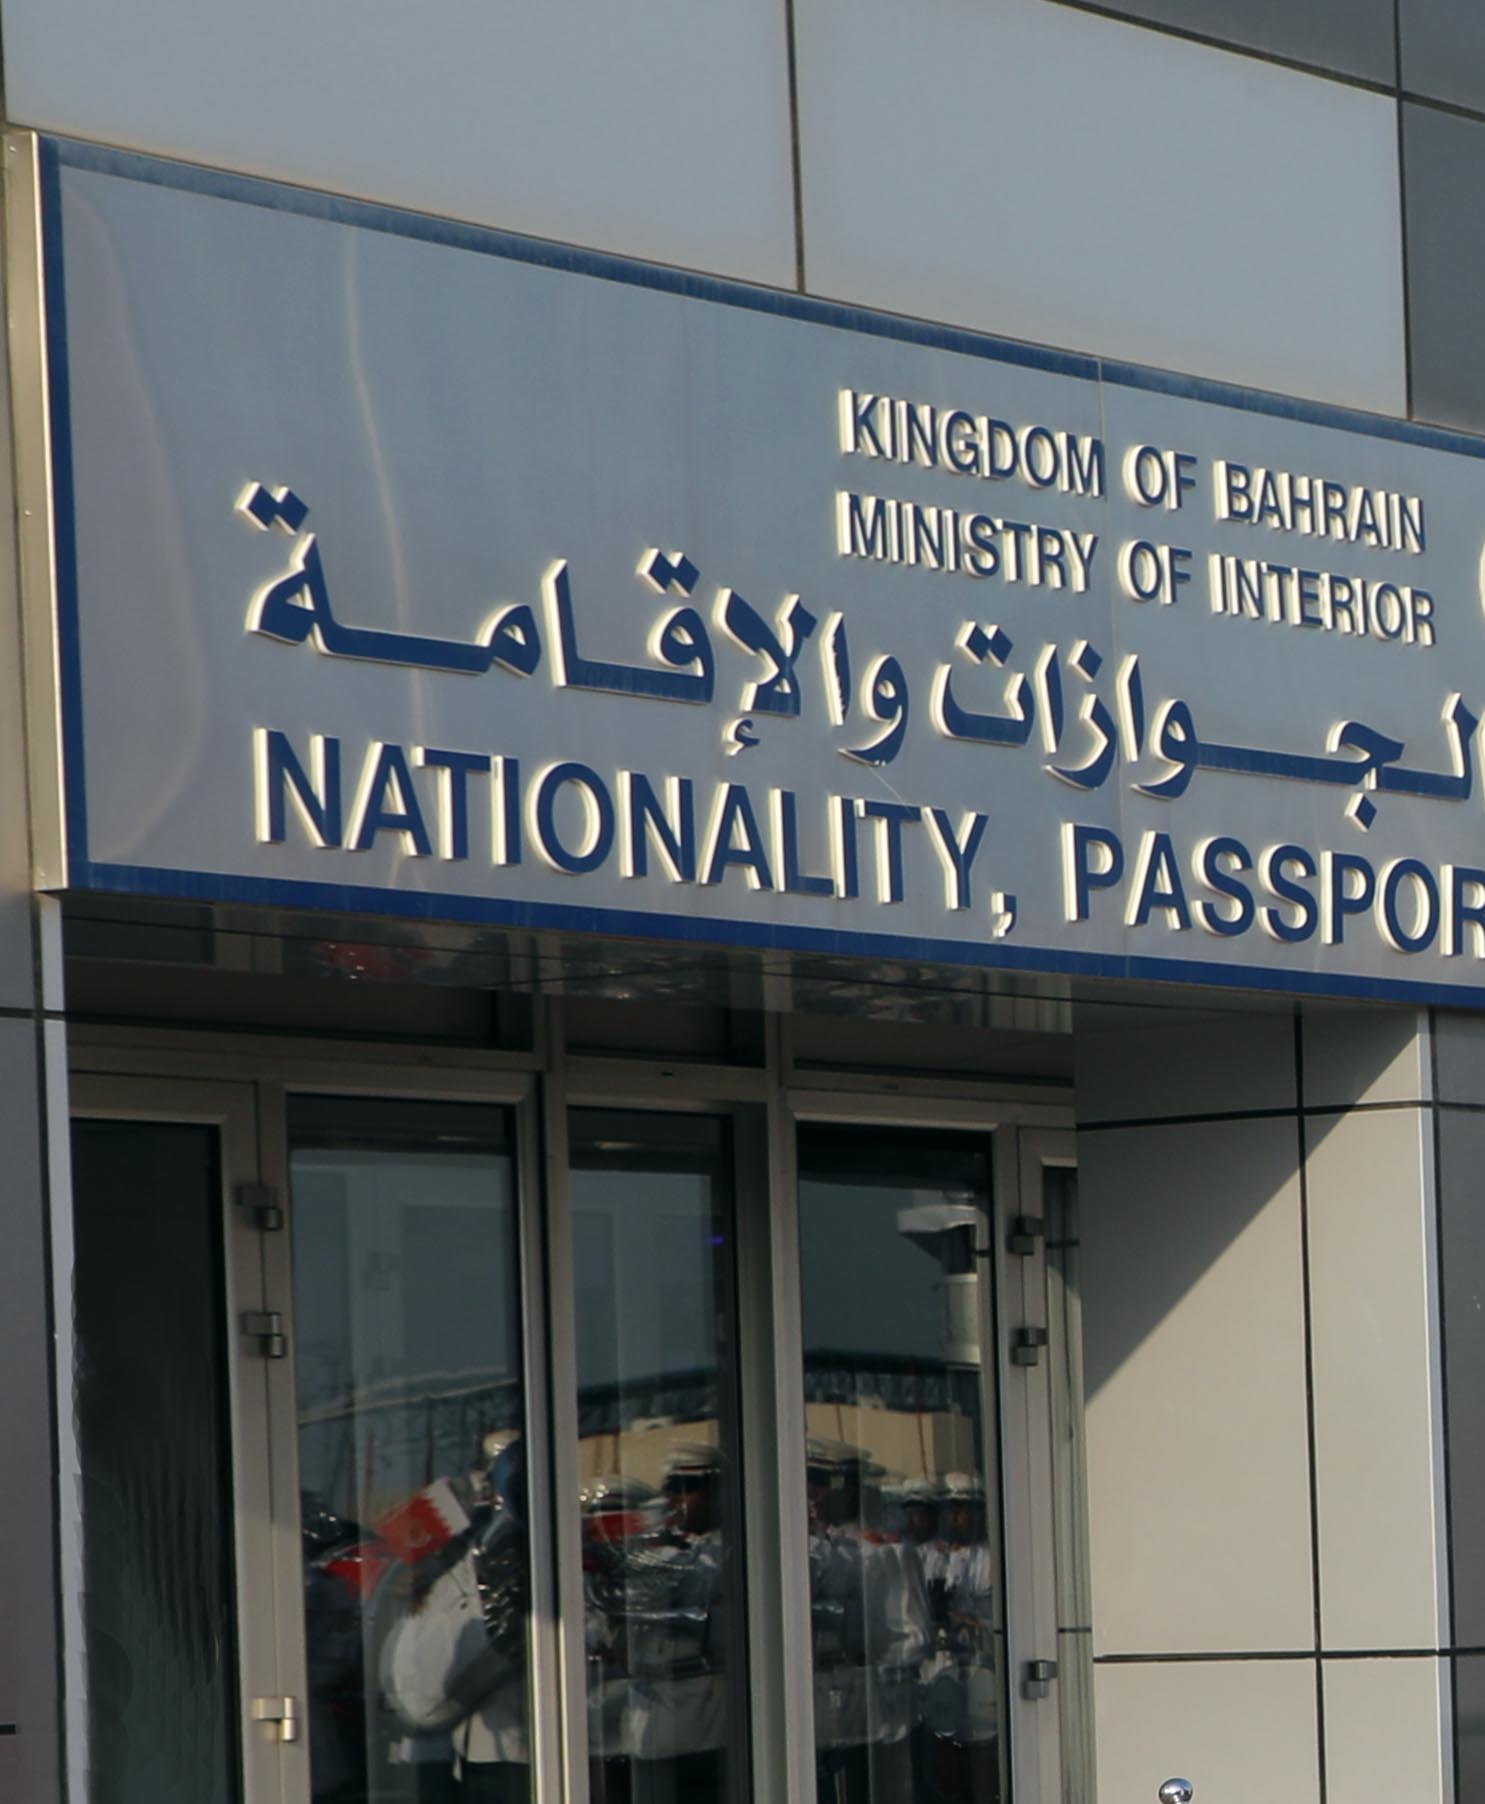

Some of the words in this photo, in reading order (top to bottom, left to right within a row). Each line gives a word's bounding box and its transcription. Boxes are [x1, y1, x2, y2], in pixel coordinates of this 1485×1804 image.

[838, 386, 1105, 498] KINGDOM
[1124, 440, 1198, 512] OF
[1213, 458, 1424, 554] BAHRAIN
[835, 491, 1099, 596] MINISTRY
[1117, 538, 1193, 606] OF
[1207, 553, 1437, 648] INTERIOR
[253, 726, 1018, 939] NATIONALITY,
